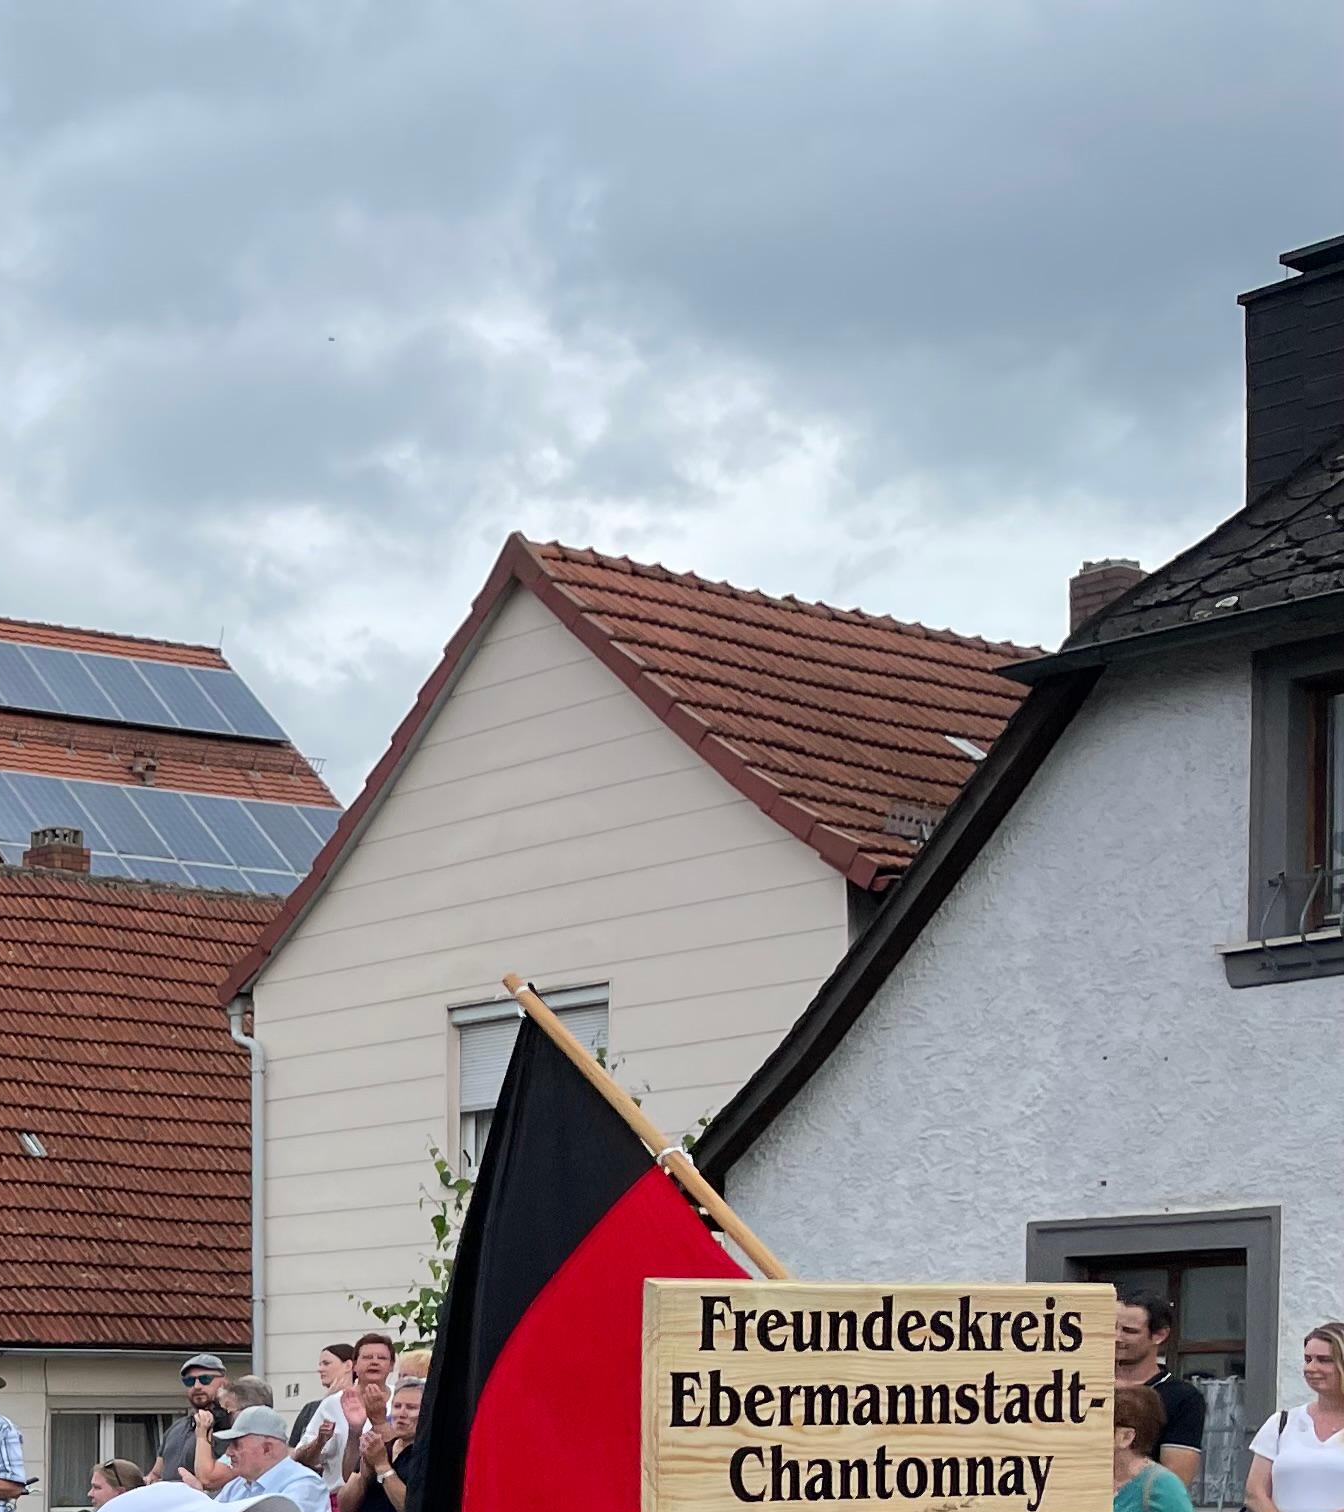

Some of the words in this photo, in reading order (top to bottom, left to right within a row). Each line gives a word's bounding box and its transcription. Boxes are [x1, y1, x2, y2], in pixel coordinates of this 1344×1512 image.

[698, 1294, 1084, 1353] Freundeskreis
[668, 1369, 1106, 1428] Ebermannstadt-
[729, 1445, 1054, 1512] Chantonnay
